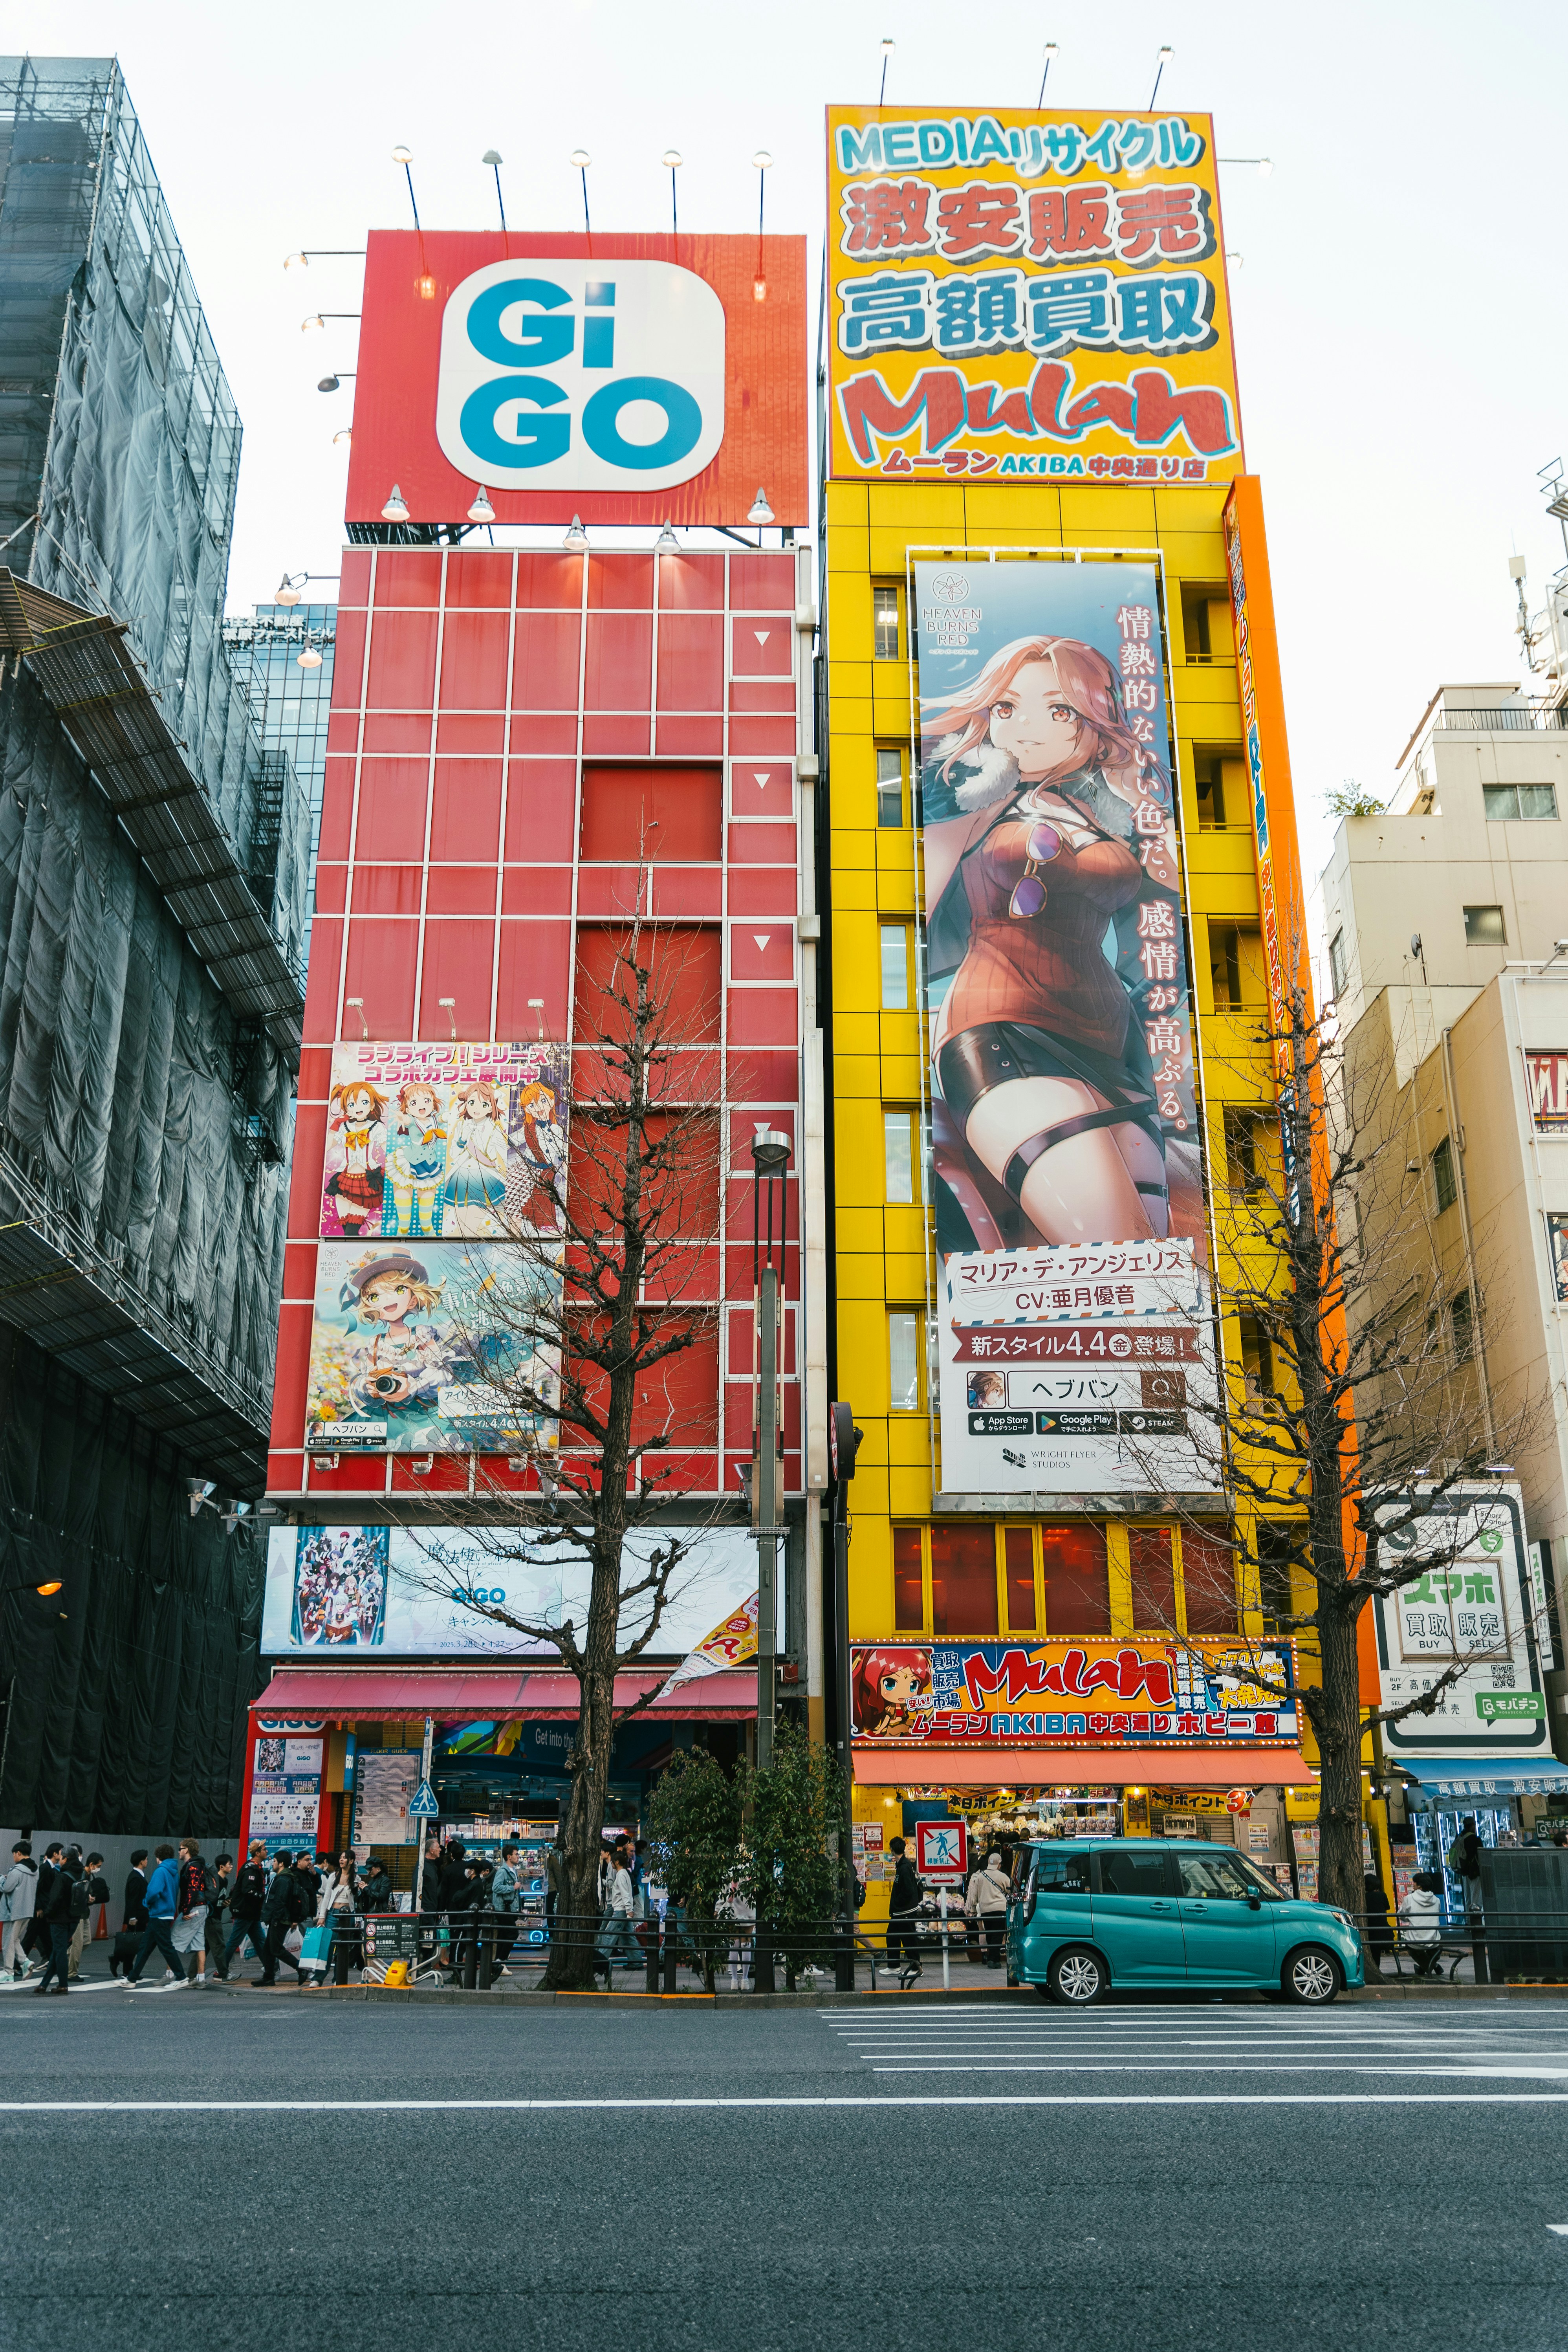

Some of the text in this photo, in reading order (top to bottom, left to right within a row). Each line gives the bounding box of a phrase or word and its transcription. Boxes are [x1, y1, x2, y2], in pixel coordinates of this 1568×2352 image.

[837, 117, 1200, 175] MEDIAリサイクル
[844, 179, 1203, 261] 激安販売
[841, 272, 1204, 350] 高額買取
[839, 359, 1237, 465] Mulan
[881, 450, 1206, 478] ムーラン AKIBA 中央通り店
[229, 614, 304, 627] 住友不動産
[923, 609, 980, 619] HEAVEN
[928, 621, 977, 632] BURNS
[939, 635, 967, 645] RED
[365, 1065, 541, 1084] コラボカフェ展開中
[1016, 1284, 1135, 1310] CV:亜月優音
[1032, 1379, 1119, 1399] ヘブバン
[988, 1417, 1007, 1425] App
[1060, 1414, 1092, 1425] Google
[1094, 1415, 1112, 1426] Play
[1403, 1572, 1496, 1604] スマホ
[1533, 1553, 1544, 1604] スマホ
[1407, 1613, 1500, 1637] 買取 販売
[931, 1652, 960, 1669] 買取
[932, 1672, 960, 1689] 販売
[962, 1649, 1176, 1710] Mulan
[908, 1696, 931, 1709] 安い!
[932, 1692, 961, 1710] 市場
[1496, 1698, 1539, 1710] モバデコ
[911, 1711, 1278, 1736] ムーラン AKIBA 中央通り ホビー館
[536, 1728, 574, 1748] Get into the
[1437, 1782, 1497, 1795] 高額買取
